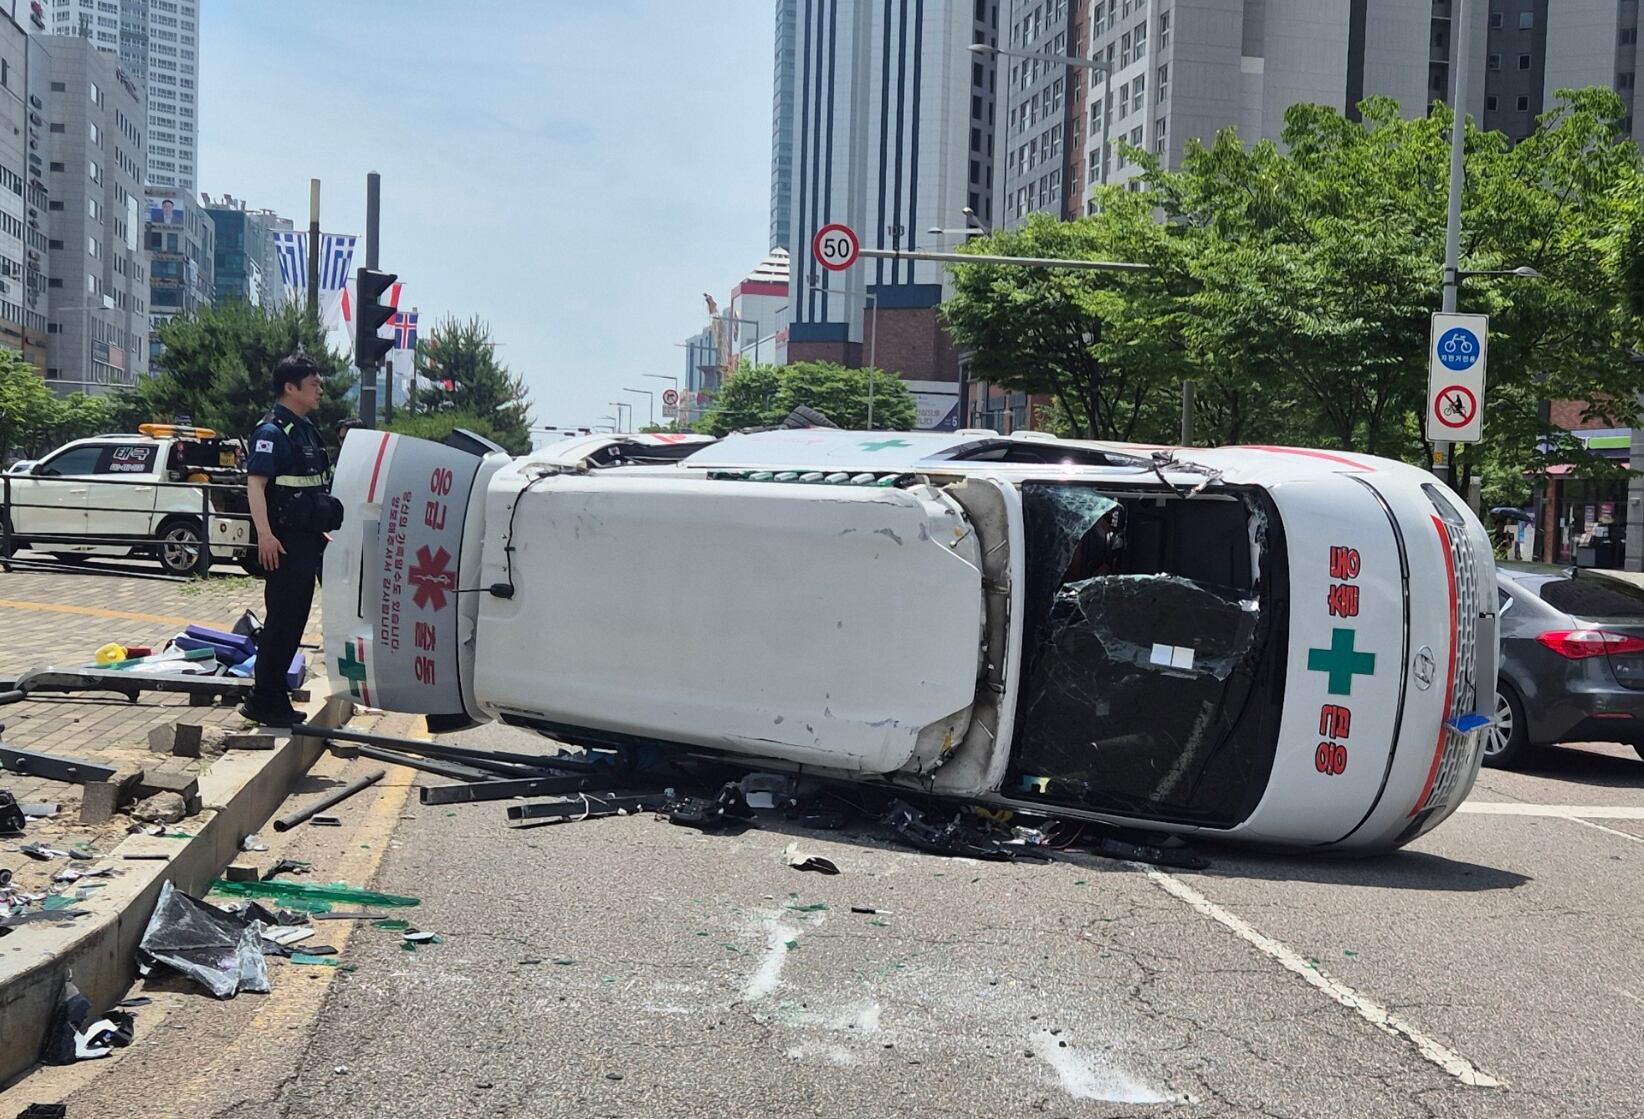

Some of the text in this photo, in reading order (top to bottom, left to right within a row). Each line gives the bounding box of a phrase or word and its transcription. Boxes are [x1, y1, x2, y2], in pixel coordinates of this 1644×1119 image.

[824, 238, 850, 258] 50
[399, 491, 412, 527] 당신의
[414, 467, 453, 686] 응급 출동
[1315, 545, 1361, 776] 응급 출동
